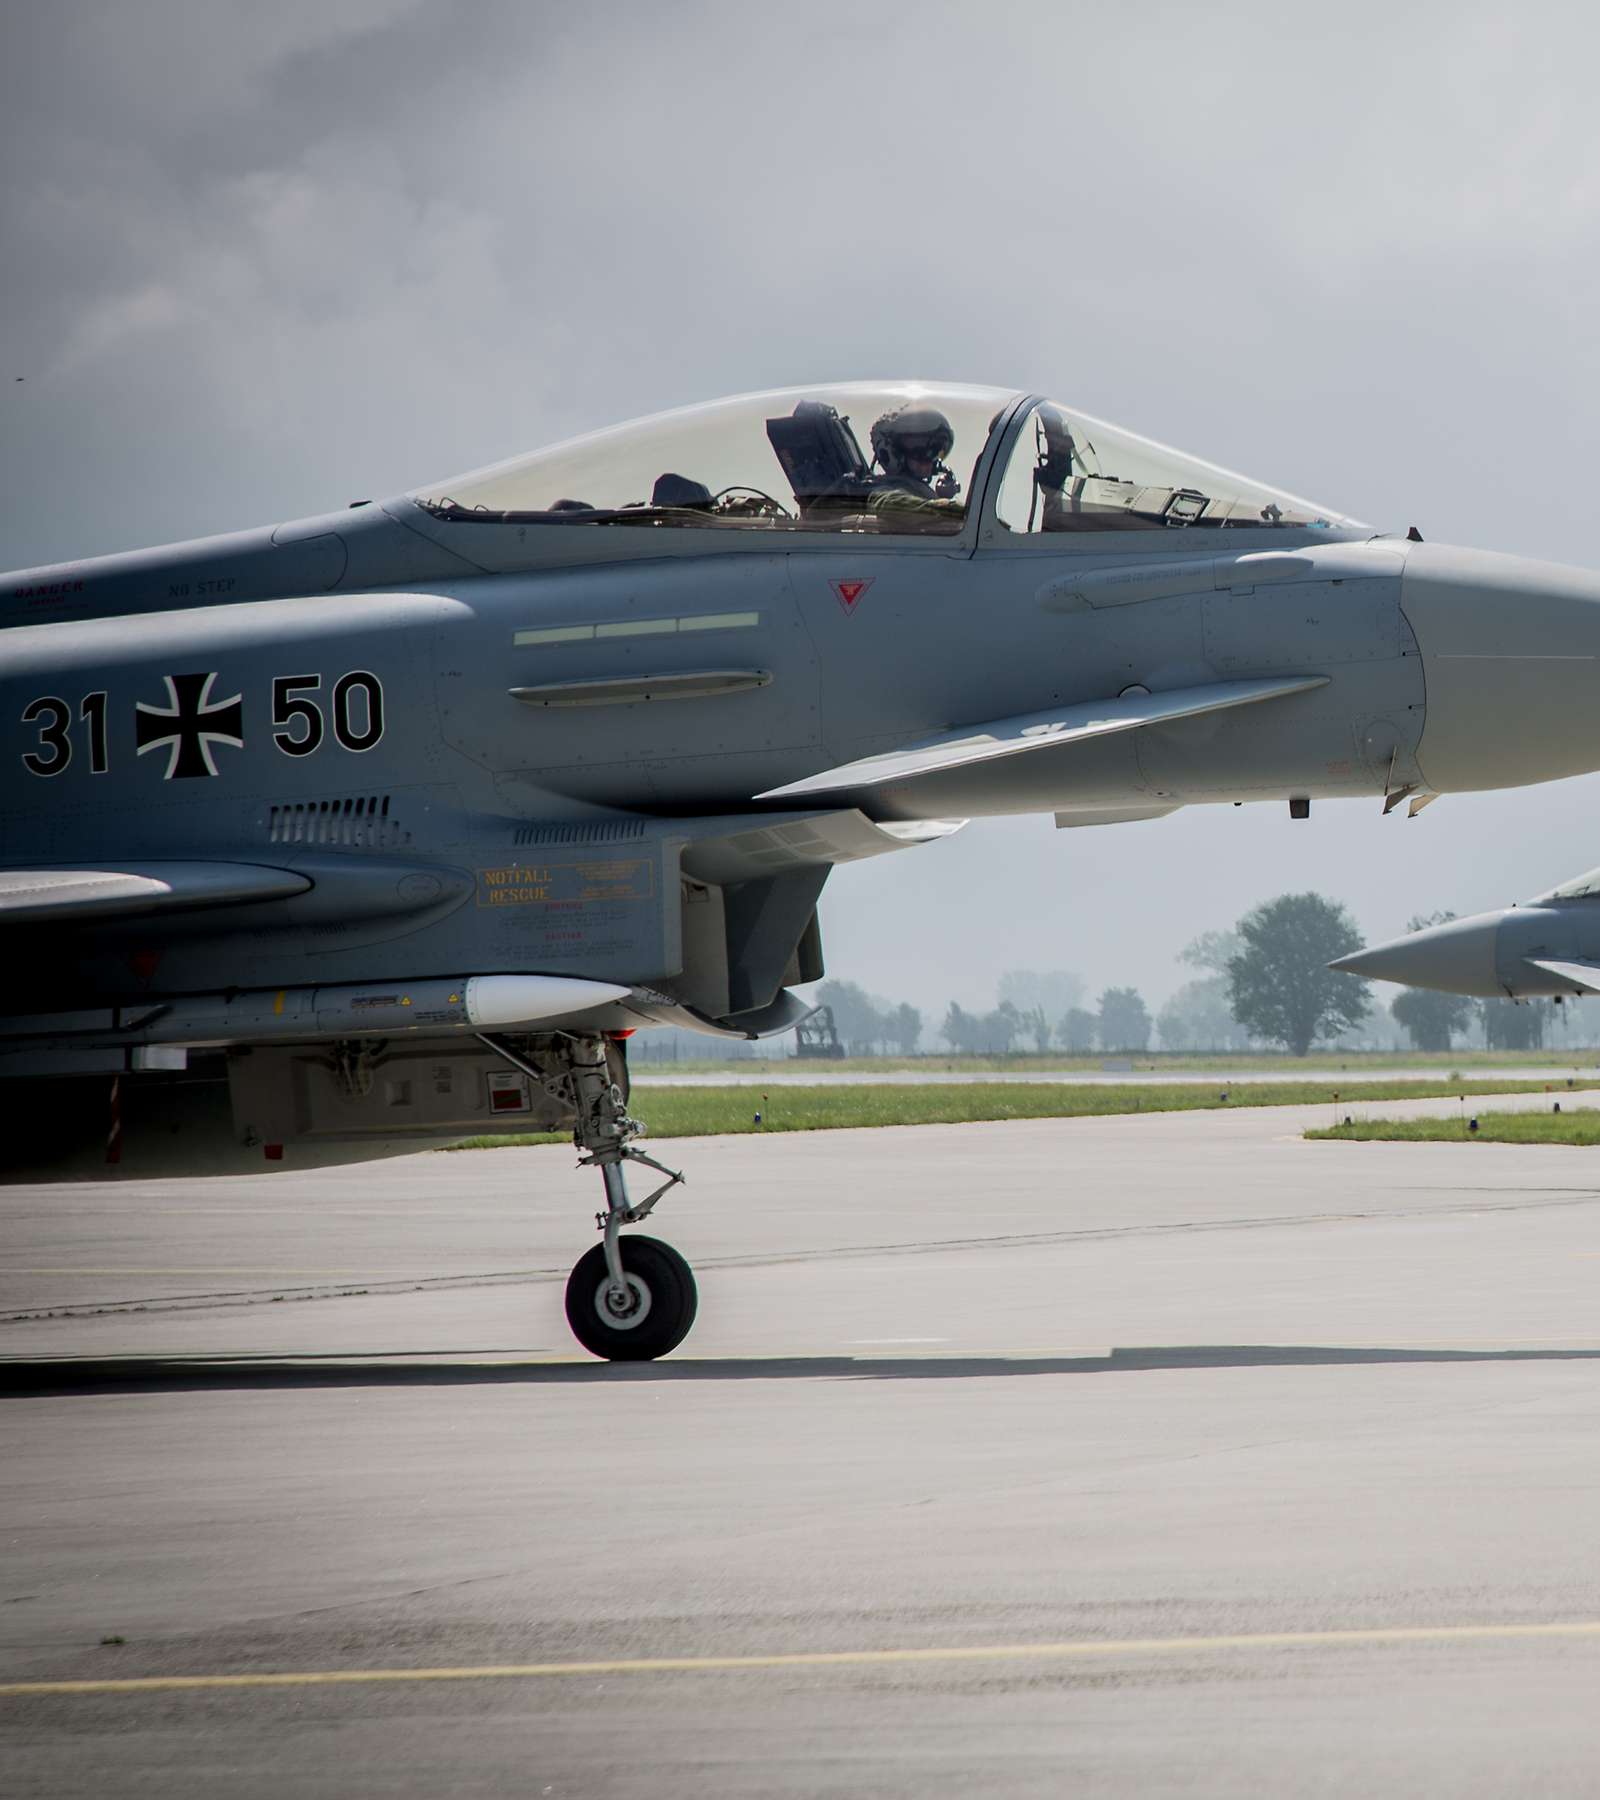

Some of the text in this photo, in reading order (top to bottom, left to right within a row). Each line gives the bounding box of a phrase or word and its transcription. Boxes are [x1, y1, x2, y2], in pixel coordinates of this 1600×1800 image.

[168, 578, 236, 597] NO STEP
[20, 671, 385, 778] 31 50
[485, 868, 552, 886] NOTFALL
[490, 887, 550, 904] RESCUE
